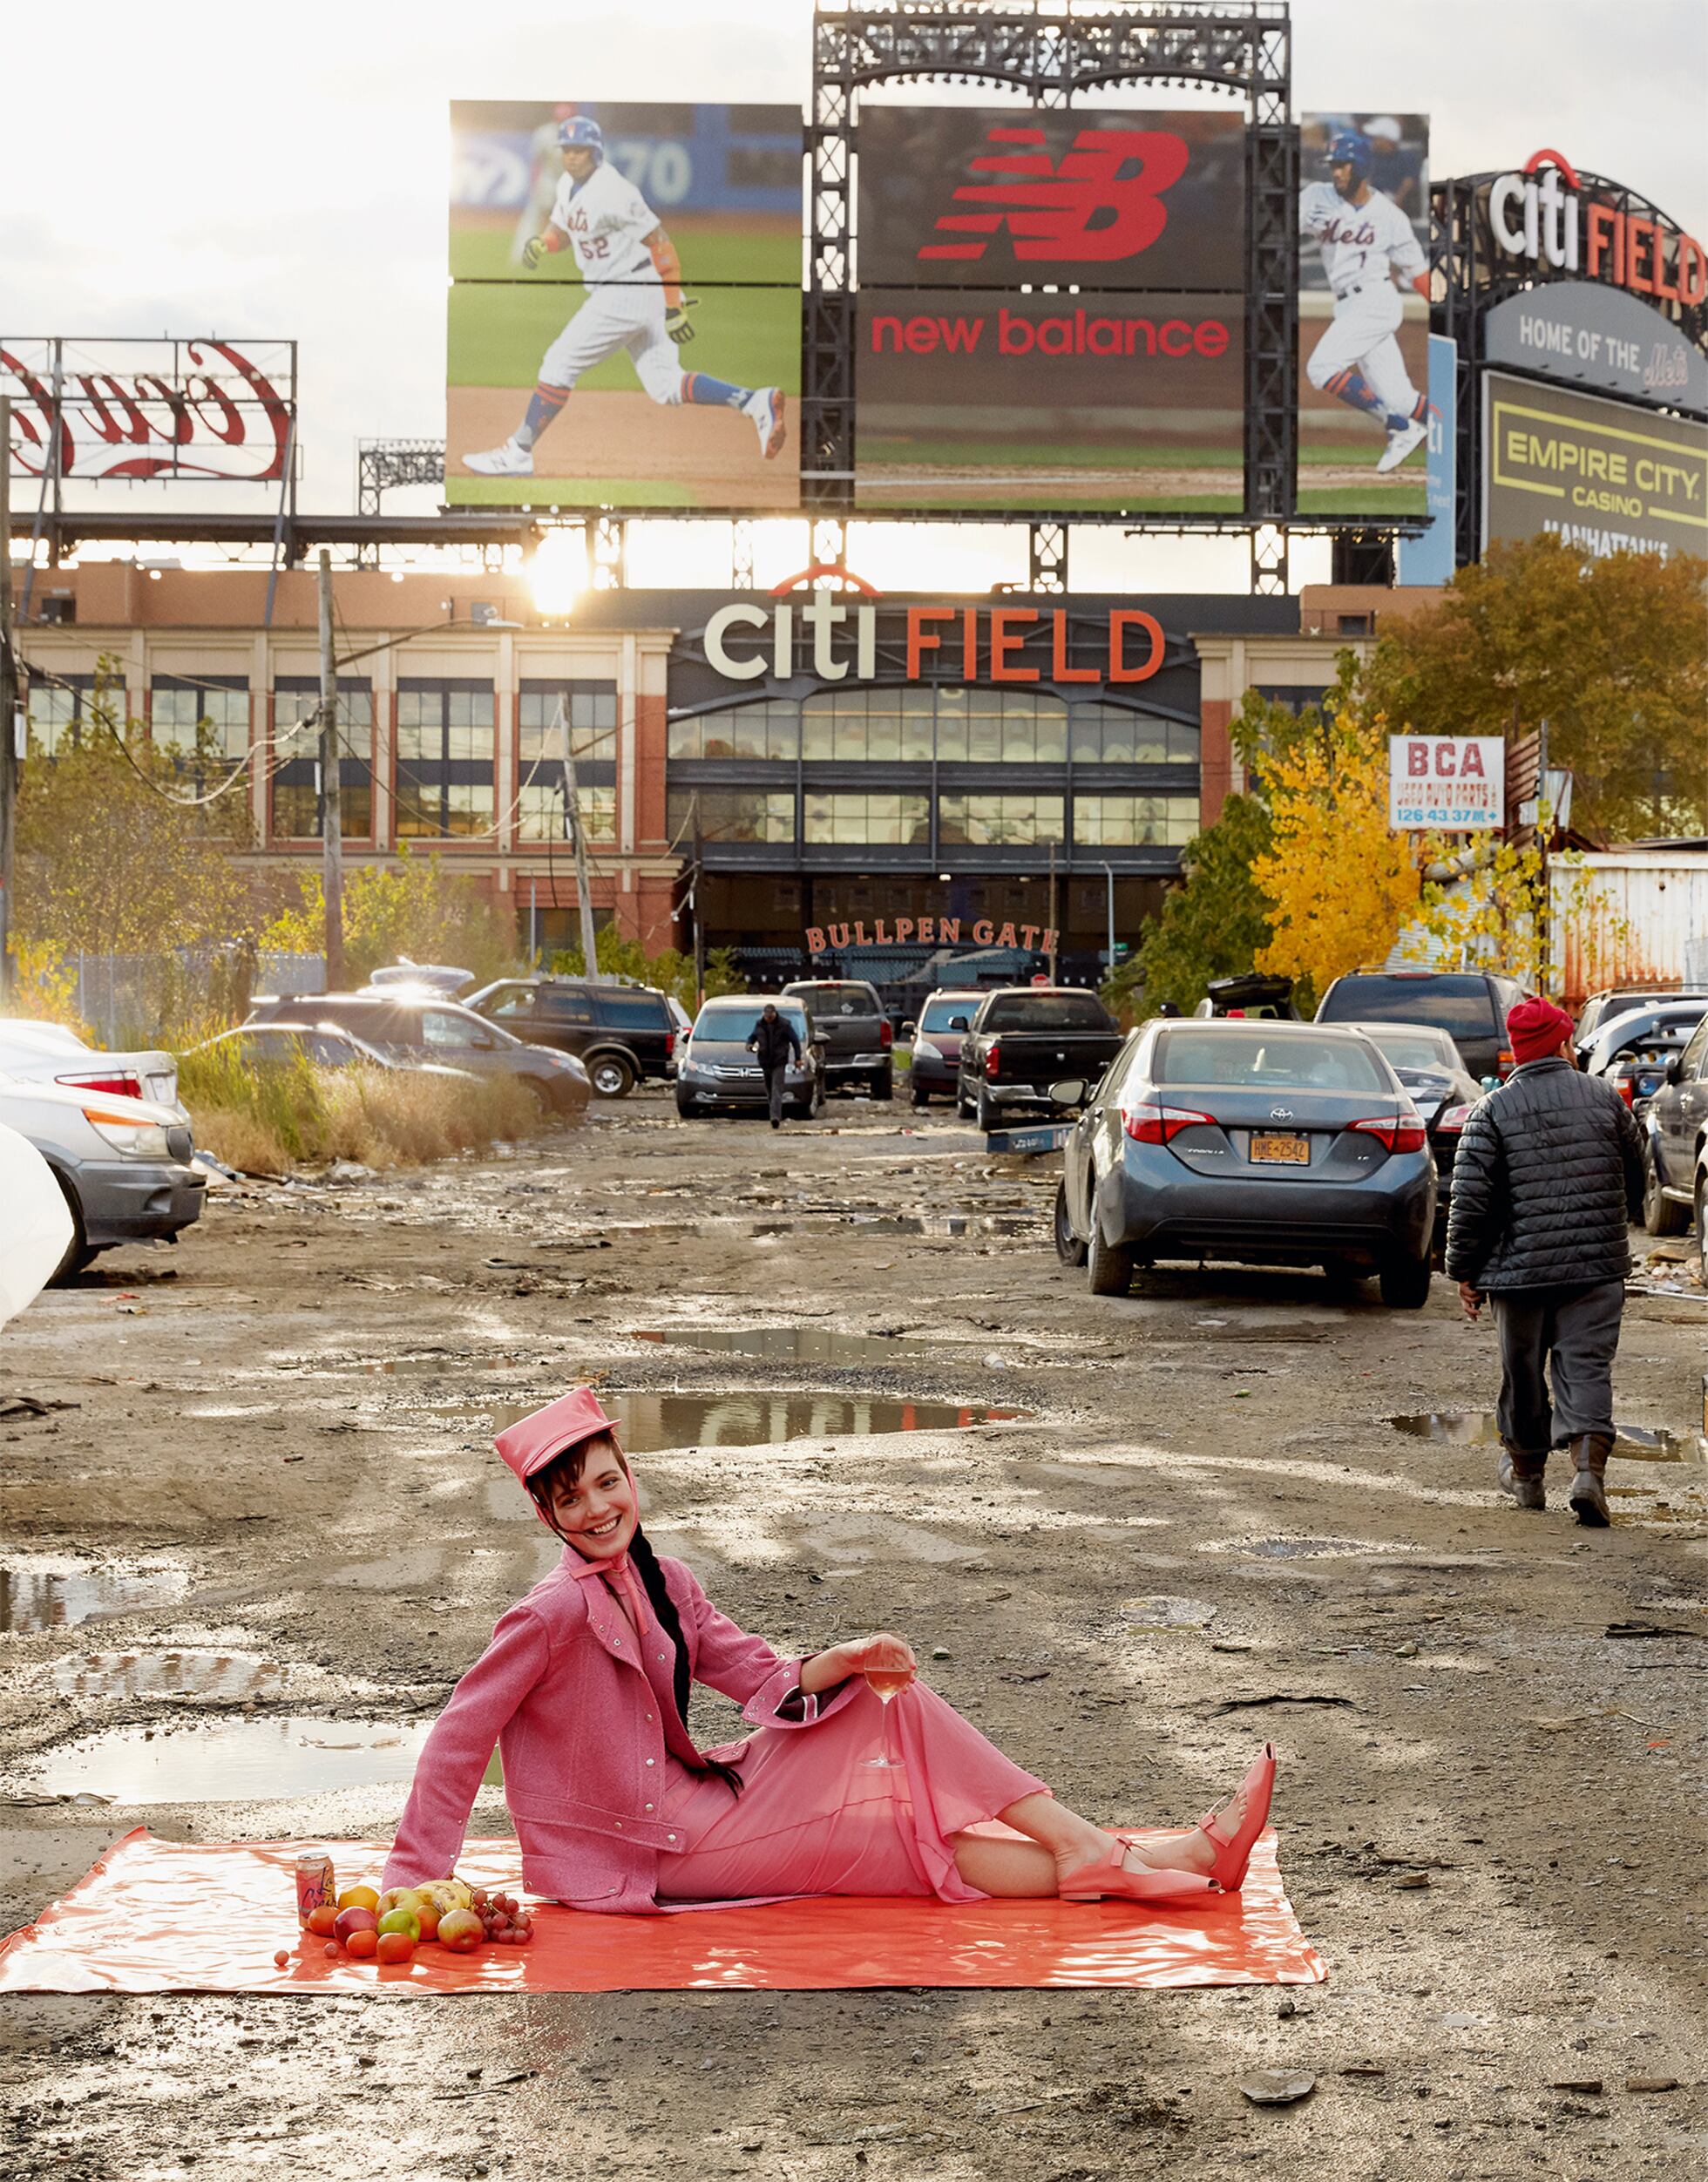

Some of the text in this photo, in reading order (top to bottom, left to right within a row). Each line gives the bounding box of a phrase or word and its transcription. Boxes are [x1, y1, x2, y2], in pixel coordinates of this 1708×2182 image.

[566, 207, 588, 233] ets
[1489, 167, 1706, 306] citi FIELD
[578, 237, 611, 261] 52
[871, 308, 1230, 357] new balance
[1519, 315, 1574, 356] HOME
[1576, 330, 1603, 363] OF
[1604, 336, 1640, 374] THE
[1507, 430, 1700, 501] EMPIRE CITY
[1571, 485, 1644, 518] CASINO
[703, 586, 1166, 683] citi FIELD
[1407, 742, 1486, 778] BCA
[805, 917, 1061, 955] BULLPEN GATE
